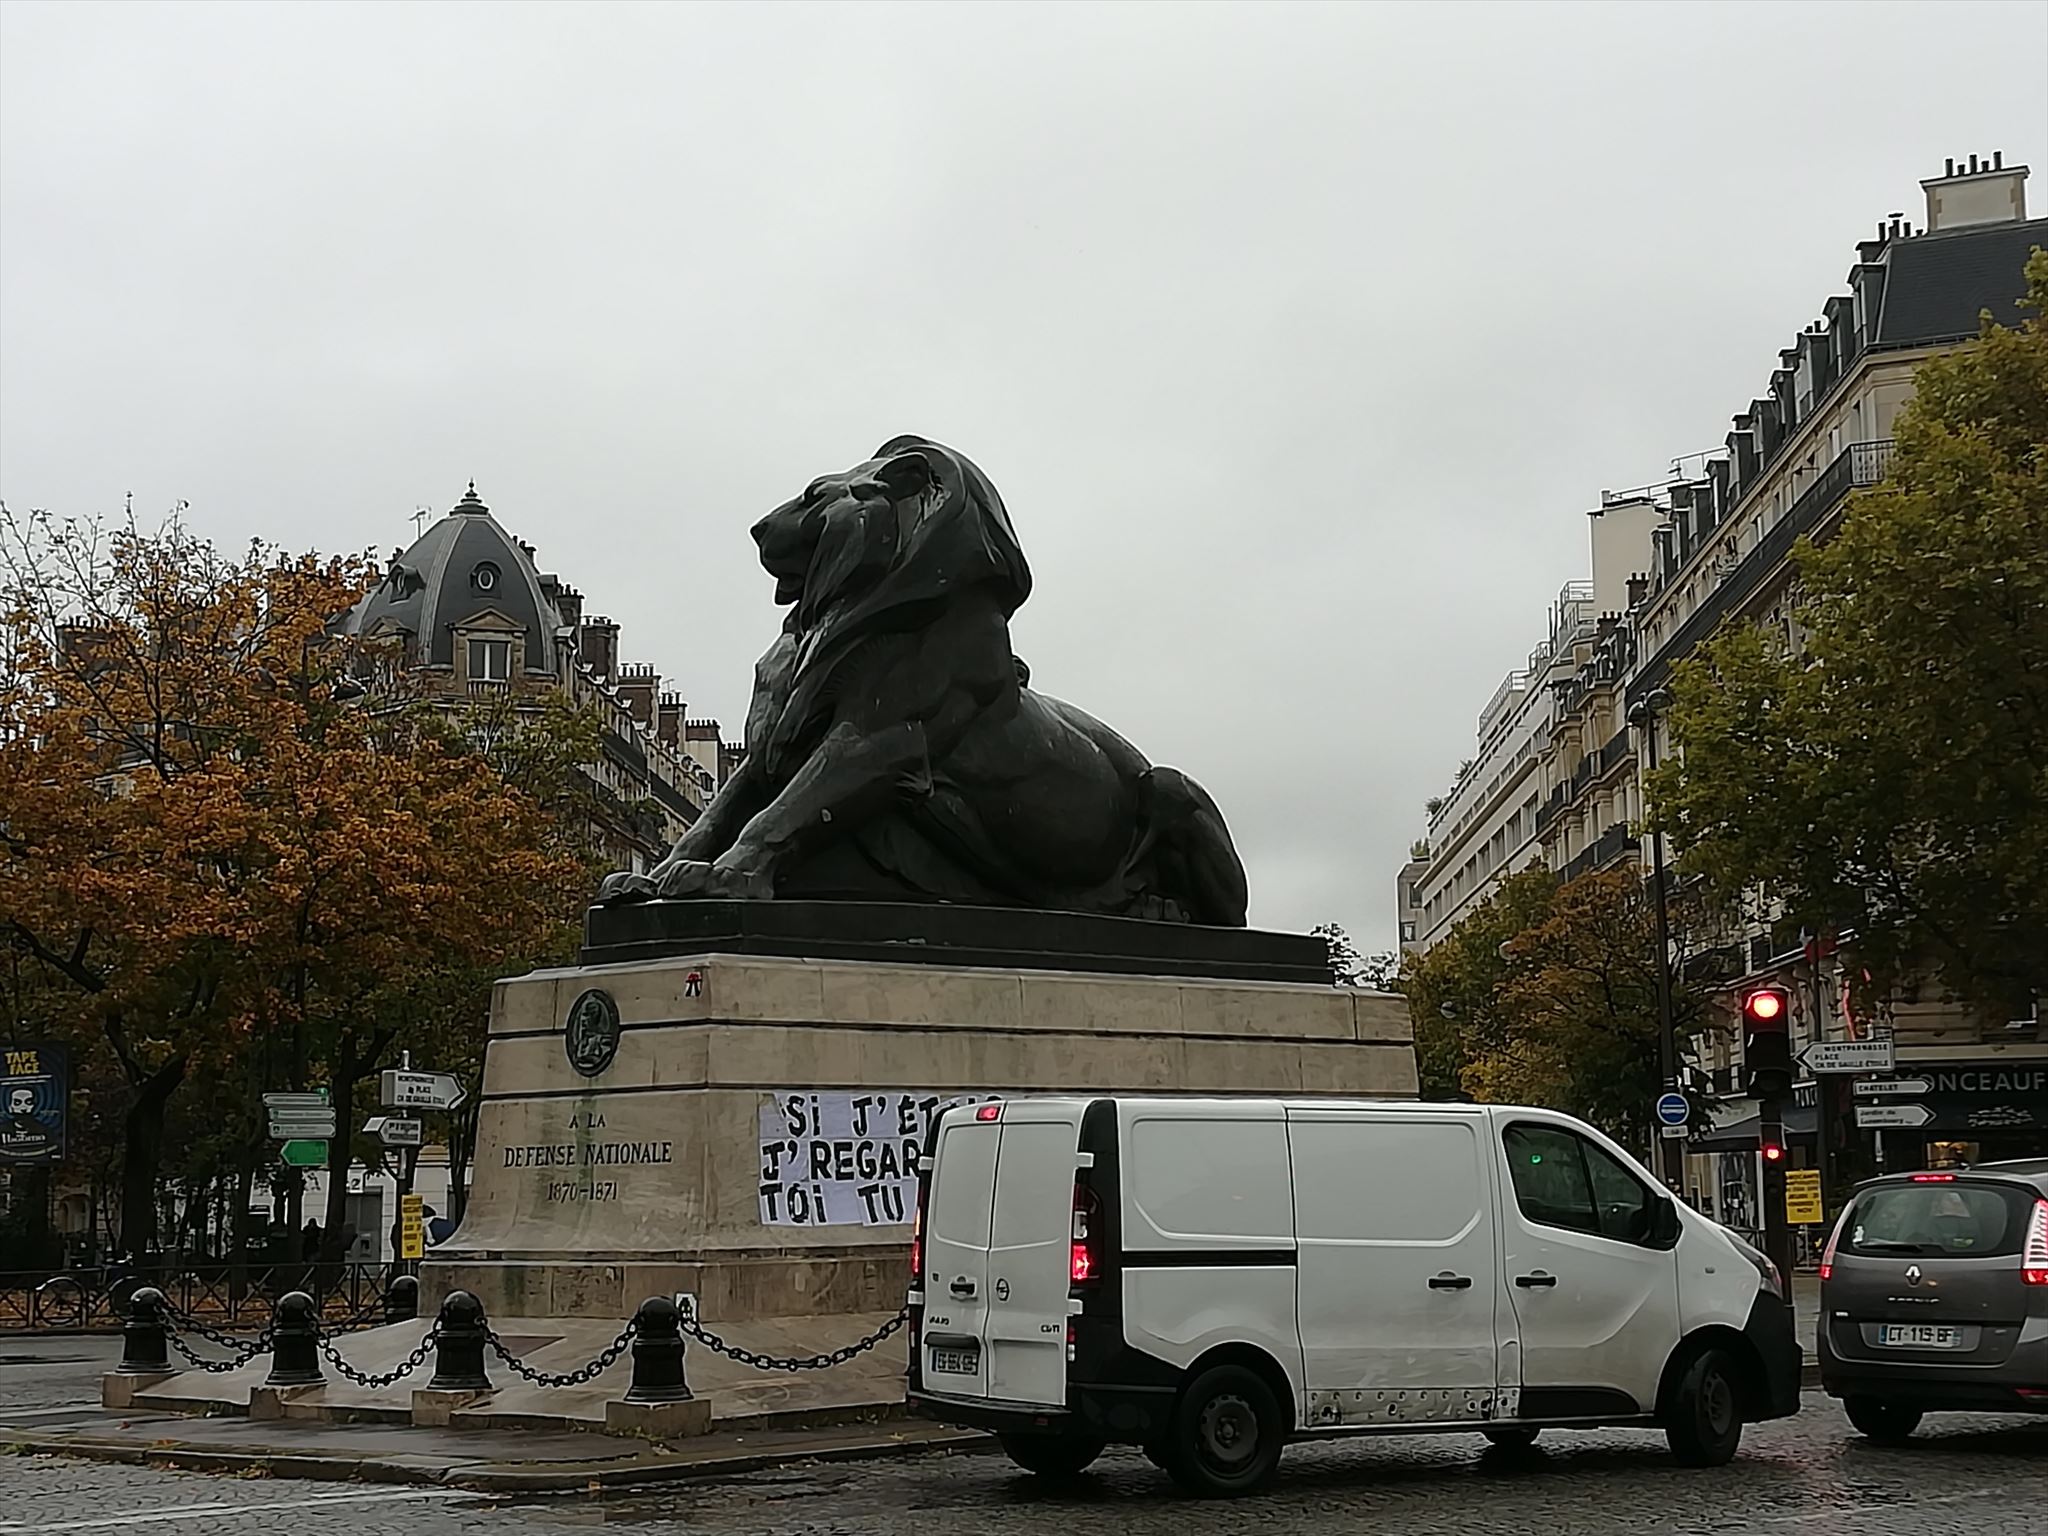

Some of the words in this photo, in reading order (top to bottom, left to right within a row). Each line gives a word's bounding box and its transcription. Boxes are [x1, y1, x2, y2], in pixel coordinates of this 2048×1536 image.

[4, 1051, 37, 1064] TAPE
[1815, 1053, 1839, 1061] PLACE
[10, 1062, 40, 1075] FACE
[568, 1114, 579, 1128] A
[587, 1113, 606, 1128] LA
[504, 1145, 576, 1168] DEFENSE
[584, 1142, 672, 1166] NATIONALE
[547, 1182, 617, 1203] 1870-1871
[857, 1183, 905, 1225] TU
